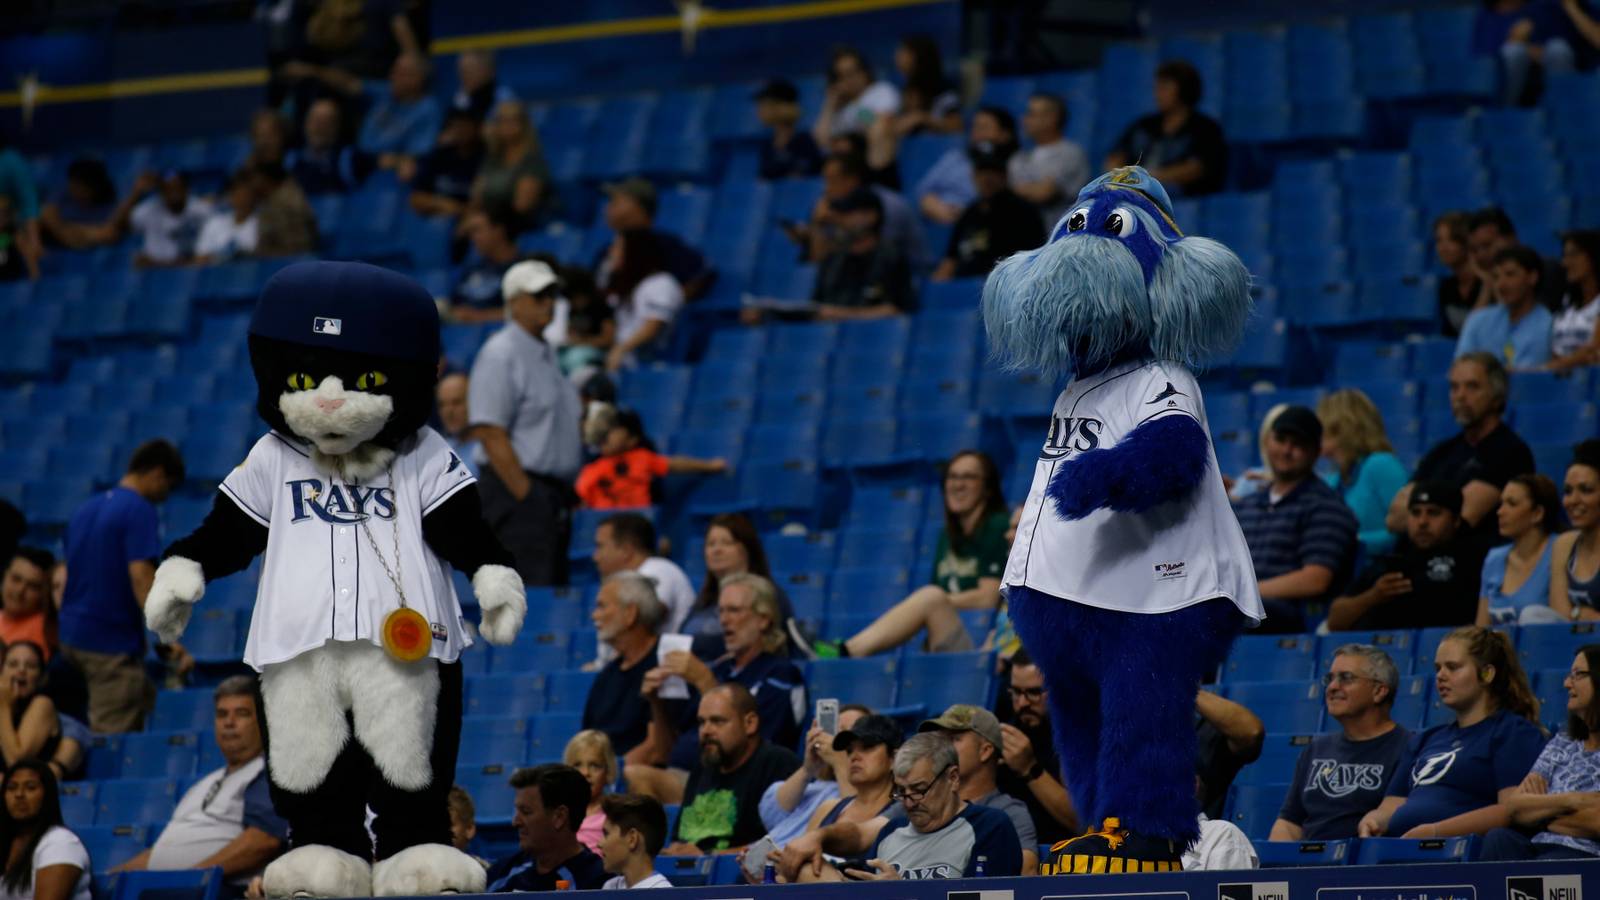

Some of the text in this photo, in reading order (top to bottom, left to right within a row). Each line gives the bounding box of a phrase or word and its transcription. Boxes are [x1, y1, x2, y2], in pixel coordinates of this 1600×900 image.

[1039, 412, 1104, 461] AYS
[285, 478, 396, 525] RAYS
[1304, 759, 1384, 797] RAYS
[895, 863, 951, 880] AYS
